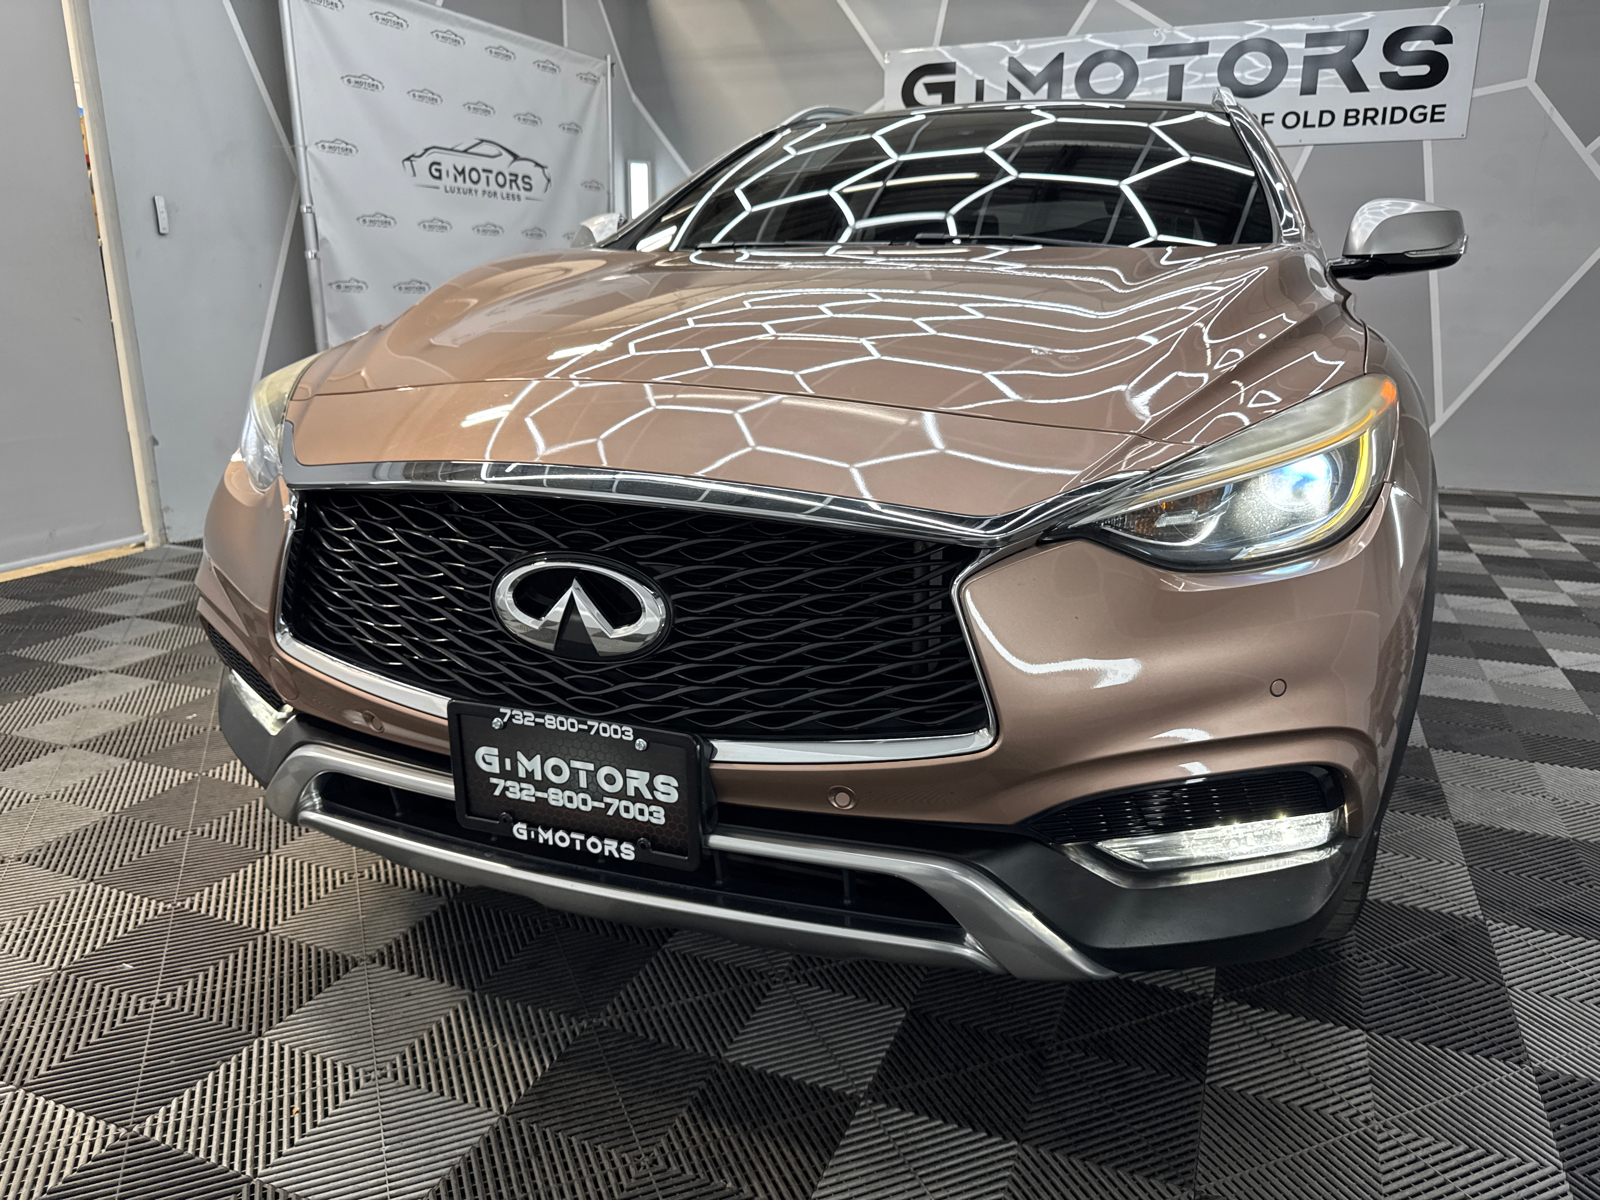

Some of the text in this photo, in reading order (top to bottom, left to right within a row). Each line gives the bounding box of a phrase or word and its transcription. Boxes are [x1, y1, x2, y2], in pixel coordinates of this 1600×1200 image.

[1282, 110, 1336, 129] OLD
[1344, 104, 1446, 127] BRIDGE
[444, 185, 522, 203] LUXURY FOR LESS
[499, 708, 634, 741] 732-800-7003
[489, 777, 666, 825] 732-800-7003
